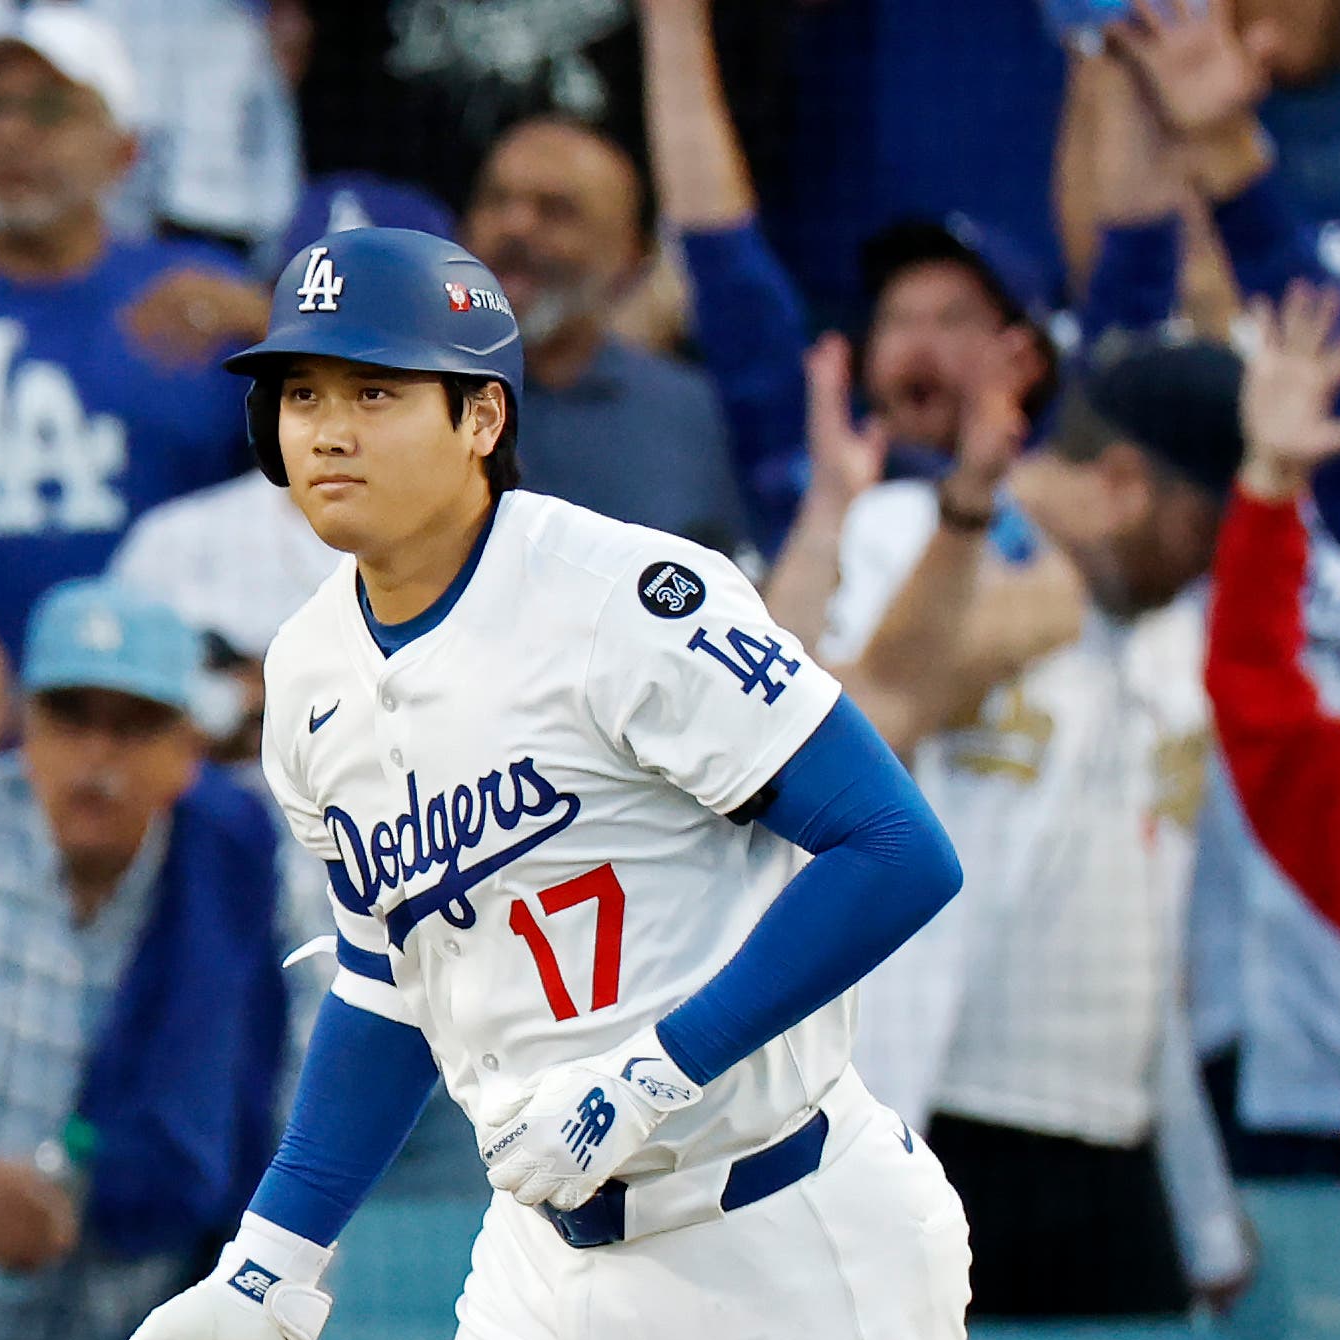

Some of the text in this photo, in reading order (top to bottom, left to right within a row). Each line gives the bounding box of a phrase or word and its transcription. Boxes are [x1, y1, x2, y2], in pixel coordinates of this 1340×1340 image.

[297, 247, 343, 311] LA
[656, 572, 699, 612] 34
[687, 626, 801, 706] LA
[323, 756, 581, 940] Dodgers
[510, 859, 627, 1022] 17
